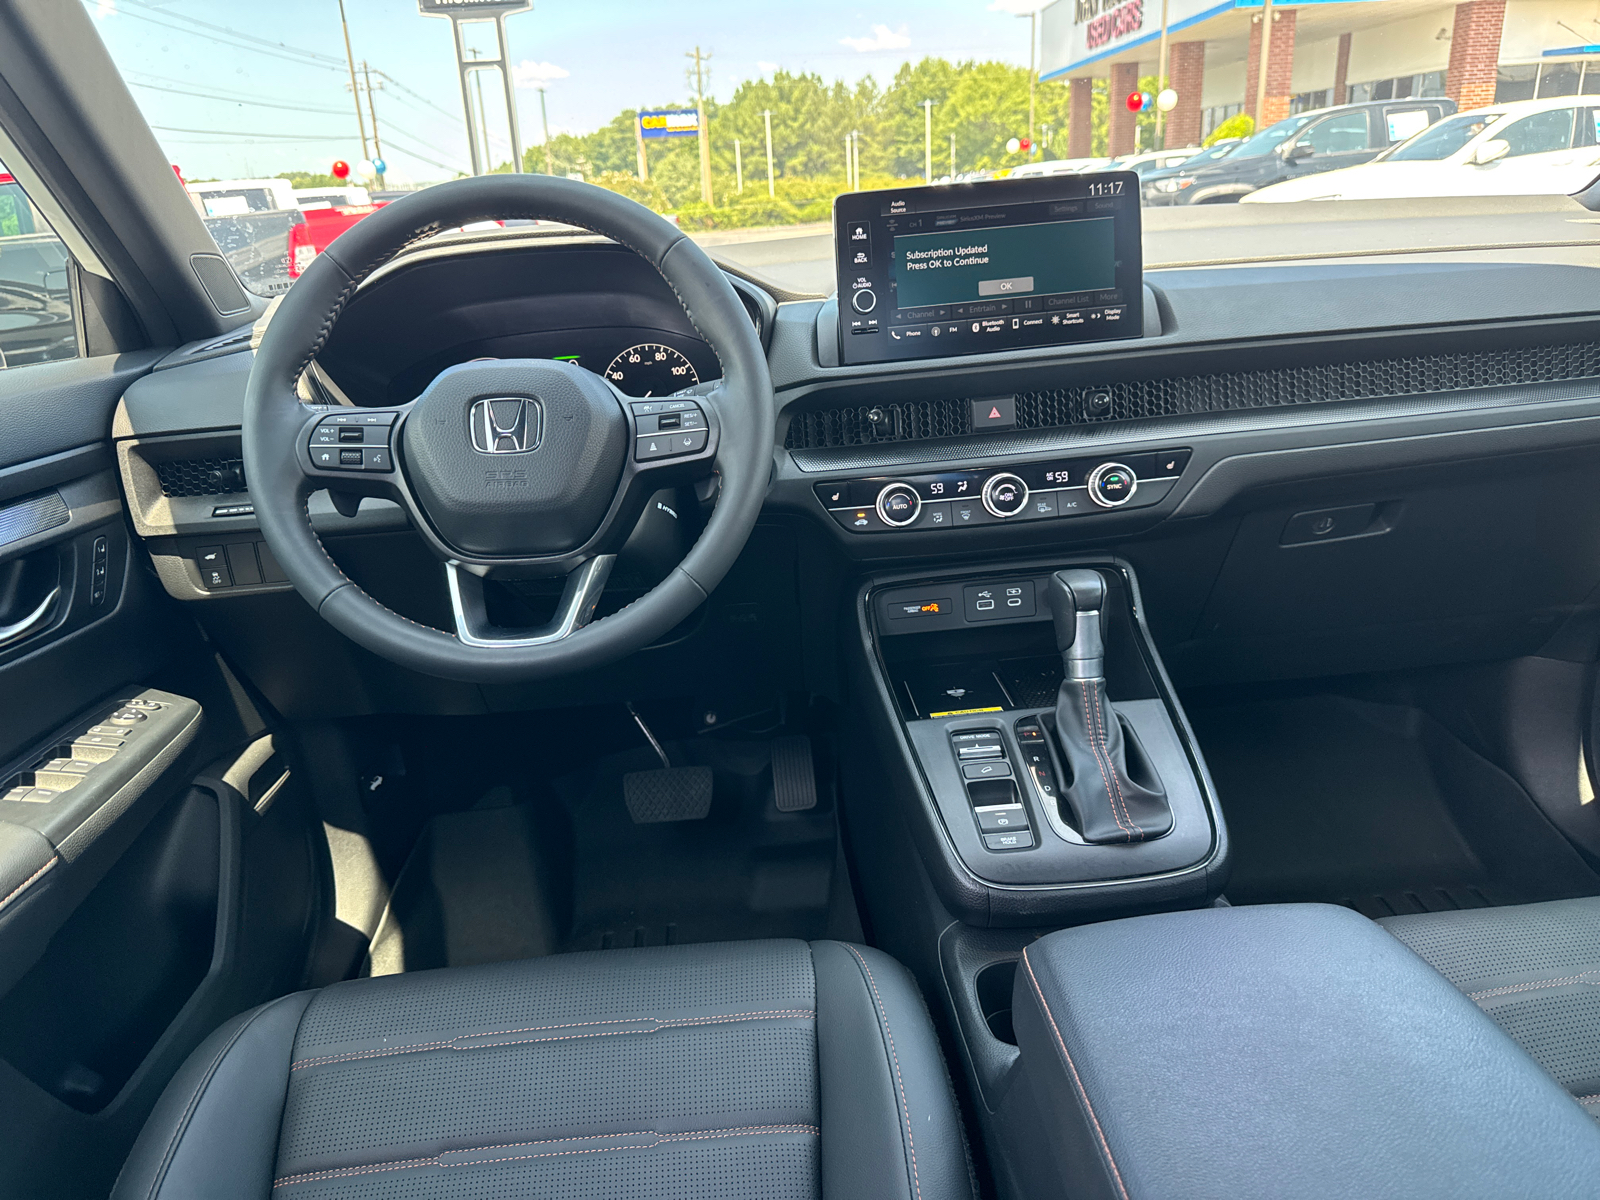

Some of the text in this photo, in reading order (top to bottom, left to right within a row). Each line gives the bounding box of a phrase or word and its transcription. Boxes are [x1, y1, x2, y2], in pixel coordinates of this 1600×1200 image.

[1088, 181, 1123, 196] 11:17
[1054, 204, 1078, 213] Settings
[906, 247, 953, 260] Subscription
[955, 244, 988, 256] Updated
[907, 256, 989, 270] Press OK to Continue
[1000, 282, 1012, 291] OK
[1048, 295, 1089, 306] Channel List
[969, 304, 996, 314] Entrtain
[907, 309, 935, 320] Channel
[628, 354, 641, 363] 60
[655, 352, 667, 361] 80
[671, 366, 686, 375] 100
[612, 372, 623, 380] 40
[1055, 471, 1069, 483] 59
[930, 483, 944, 495] 59
